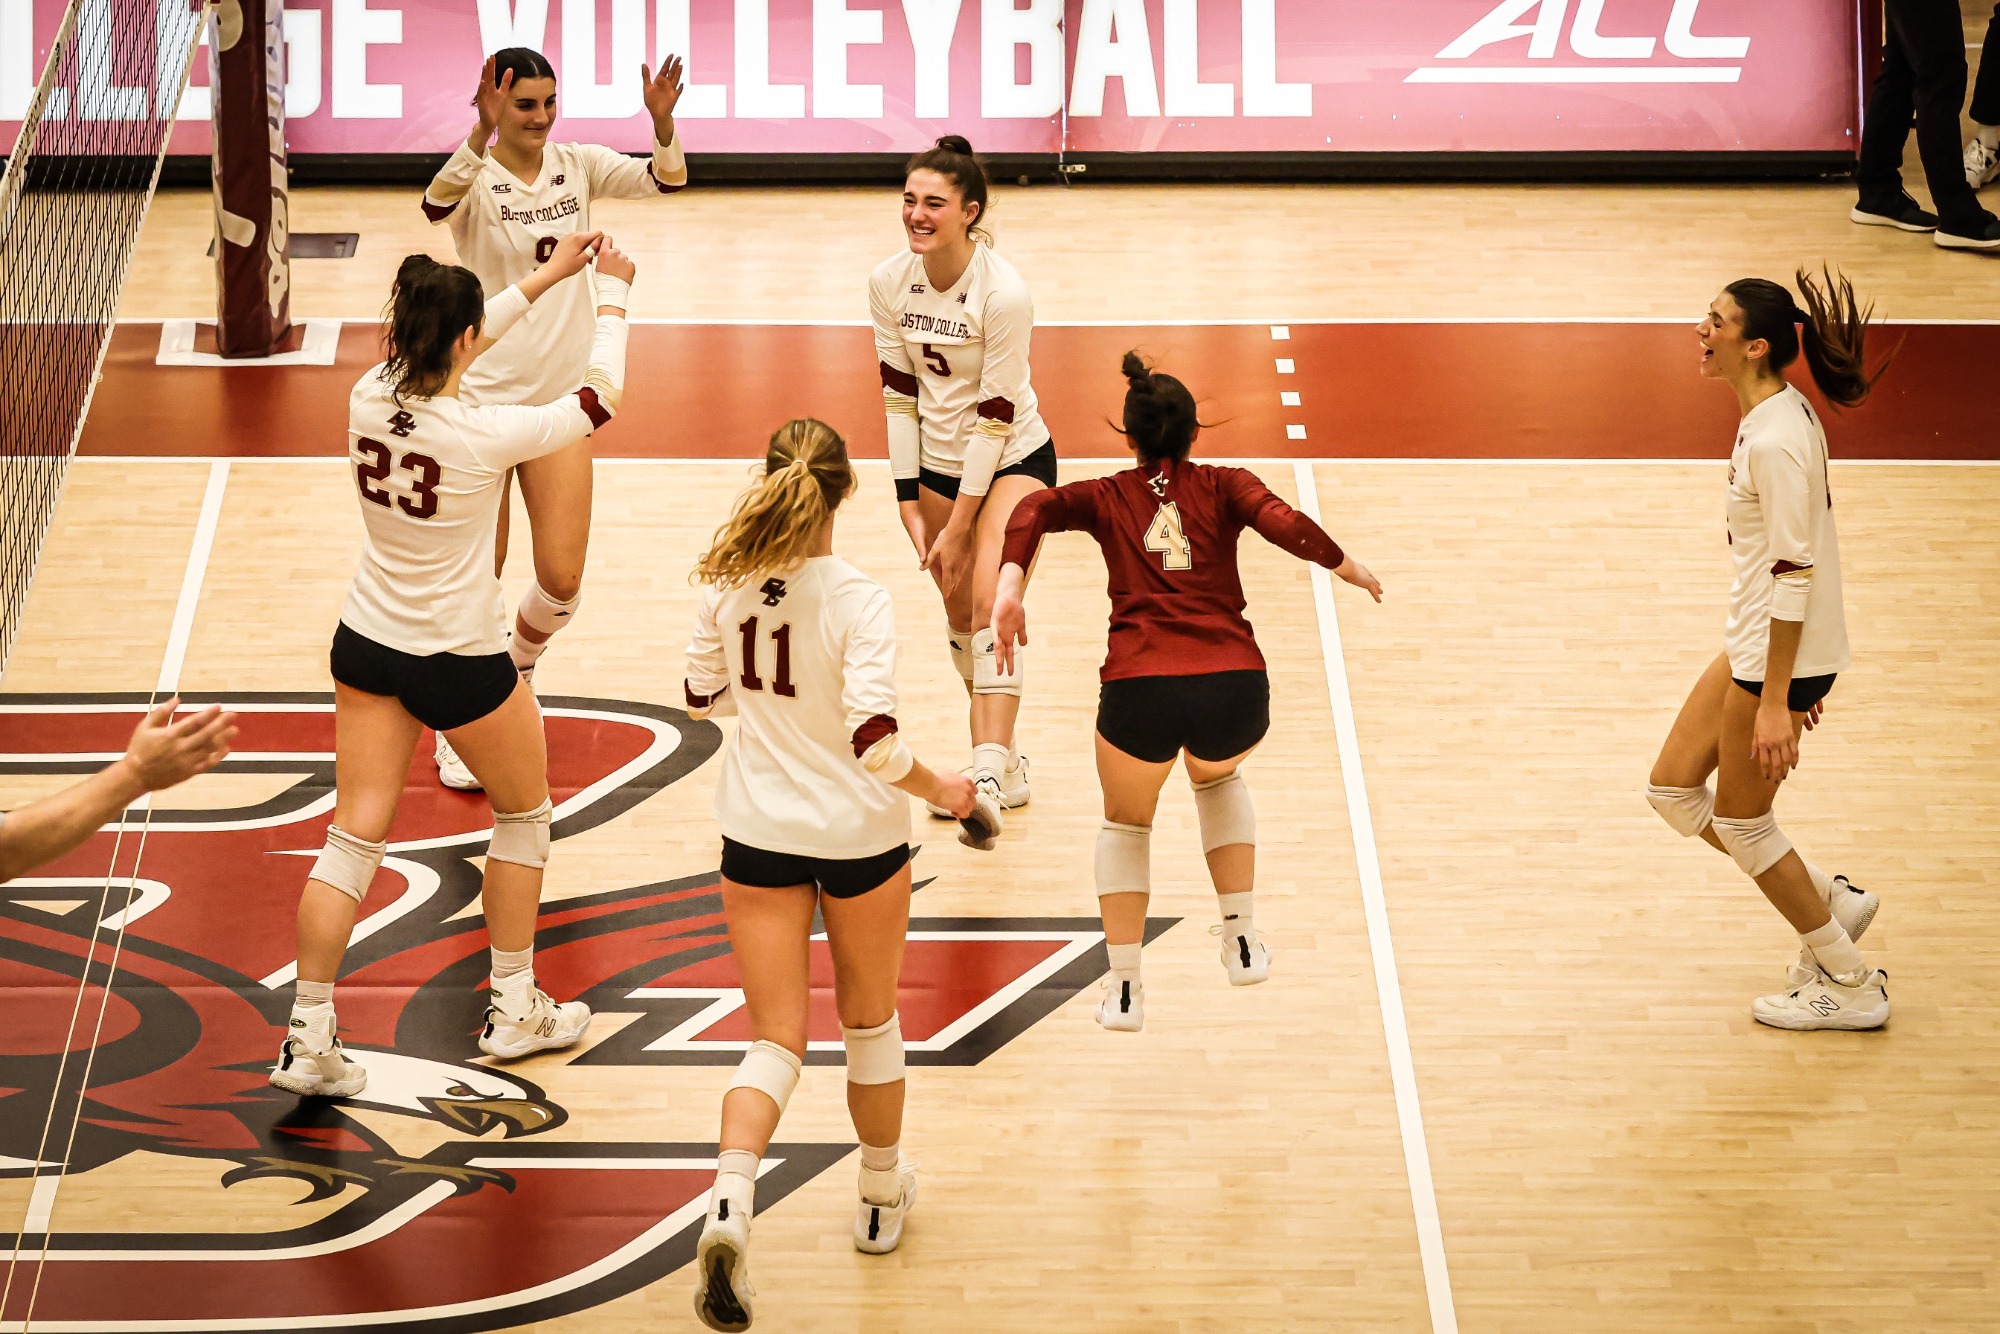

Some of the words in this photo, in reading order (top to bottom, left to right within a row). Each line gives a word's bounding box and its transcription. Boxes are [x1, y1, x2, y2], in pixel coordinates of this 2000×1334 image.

[0, 0, 403, 119] LLEE
[474, 0, 1313, 119] OLLEYBALL
[1433, 0, 1751, 59] ACC
[536, 197, 580, 222] COLLEGE
[901, 312, 936, 333] OSTON
[935, 318, 971, 339] COLLE
[922, 344, 952, 377] 5
[357, 436, 443, 520] 23
[1143, 501, 1192, 571] 4
[738, 614, 798, 699] 11
